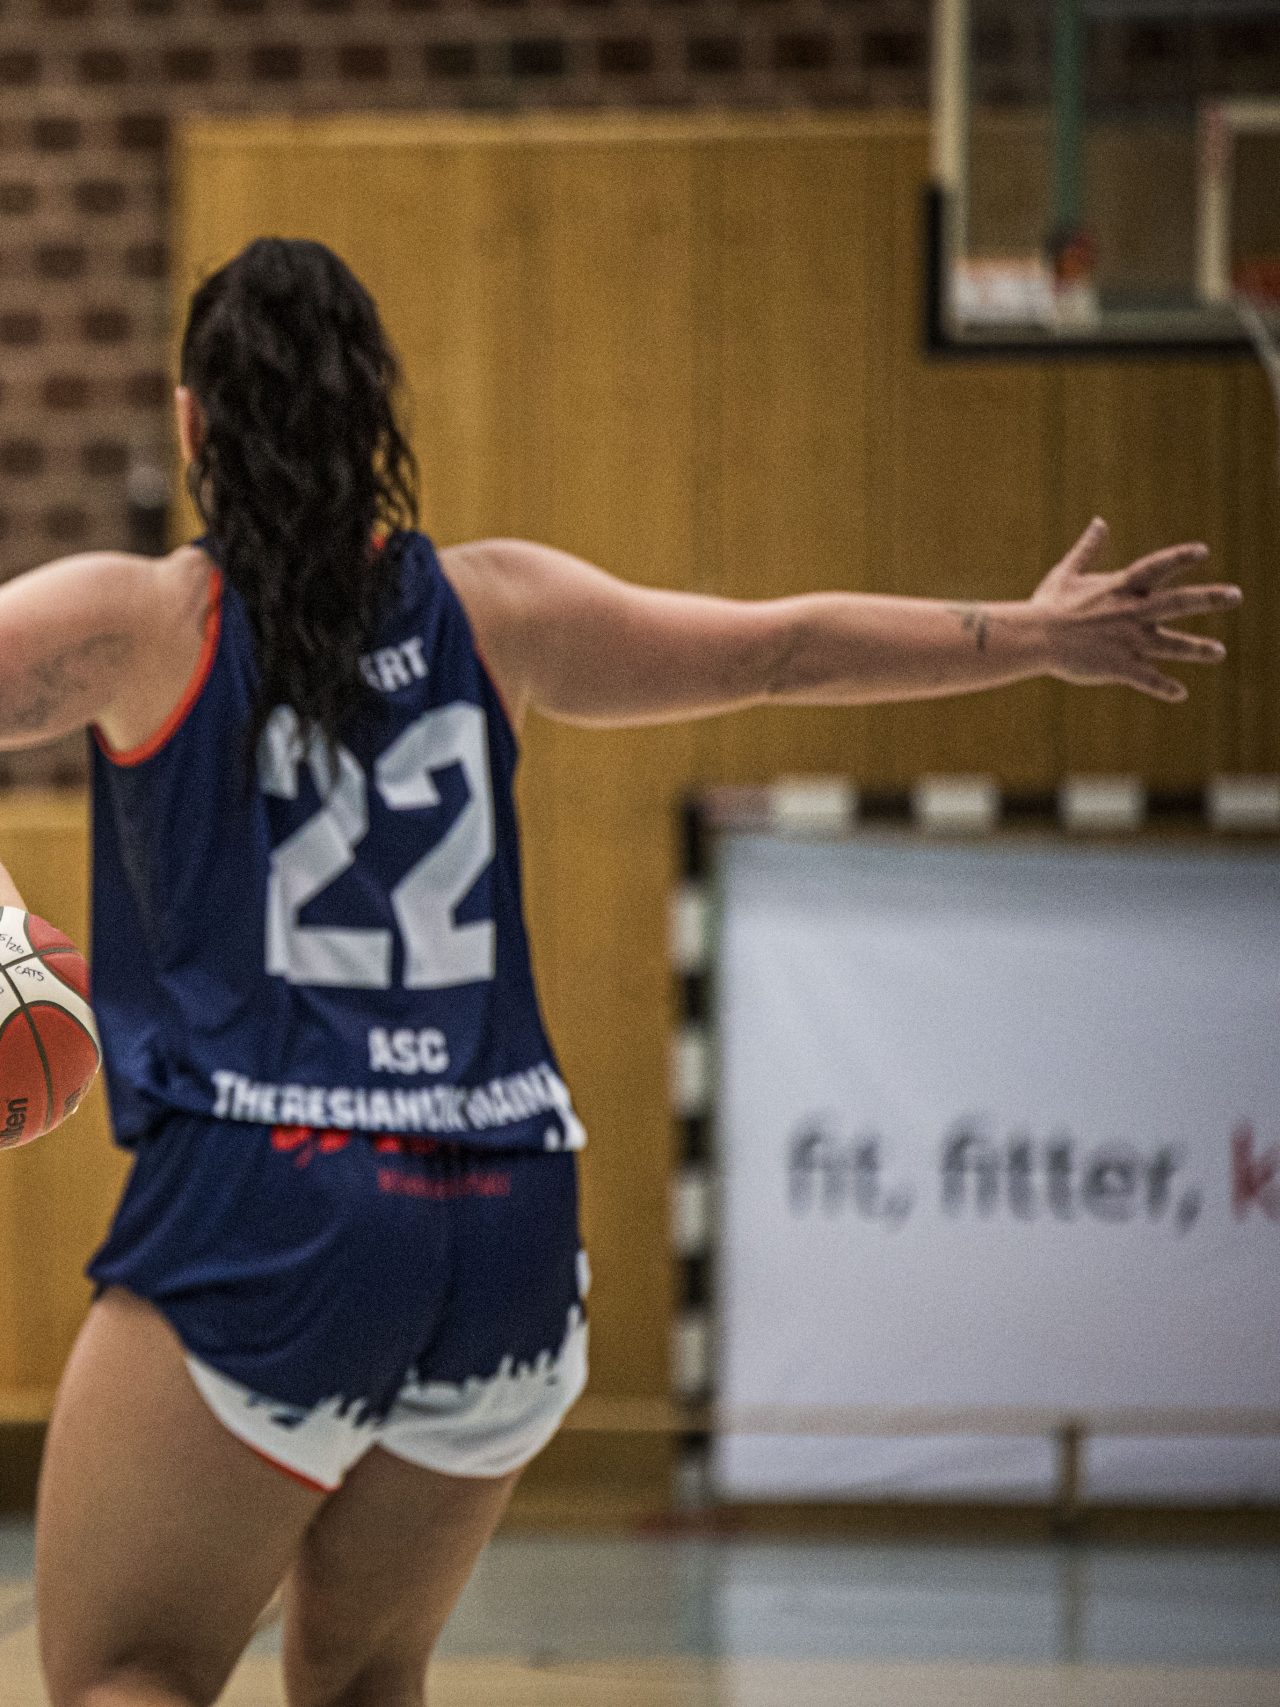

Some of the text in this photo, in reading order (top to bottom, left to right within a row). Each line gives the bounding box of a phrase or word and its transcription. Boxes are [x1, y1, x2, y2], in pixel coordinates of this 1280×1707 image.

[258, 701, 496, 990] 22
[14, 965, 45, 982] CATS
[369, 1027, 449, 1075] ASC
[786, 1110, 914, 1232] fit,
[939, 1112, 1203, 1235] fitter,
